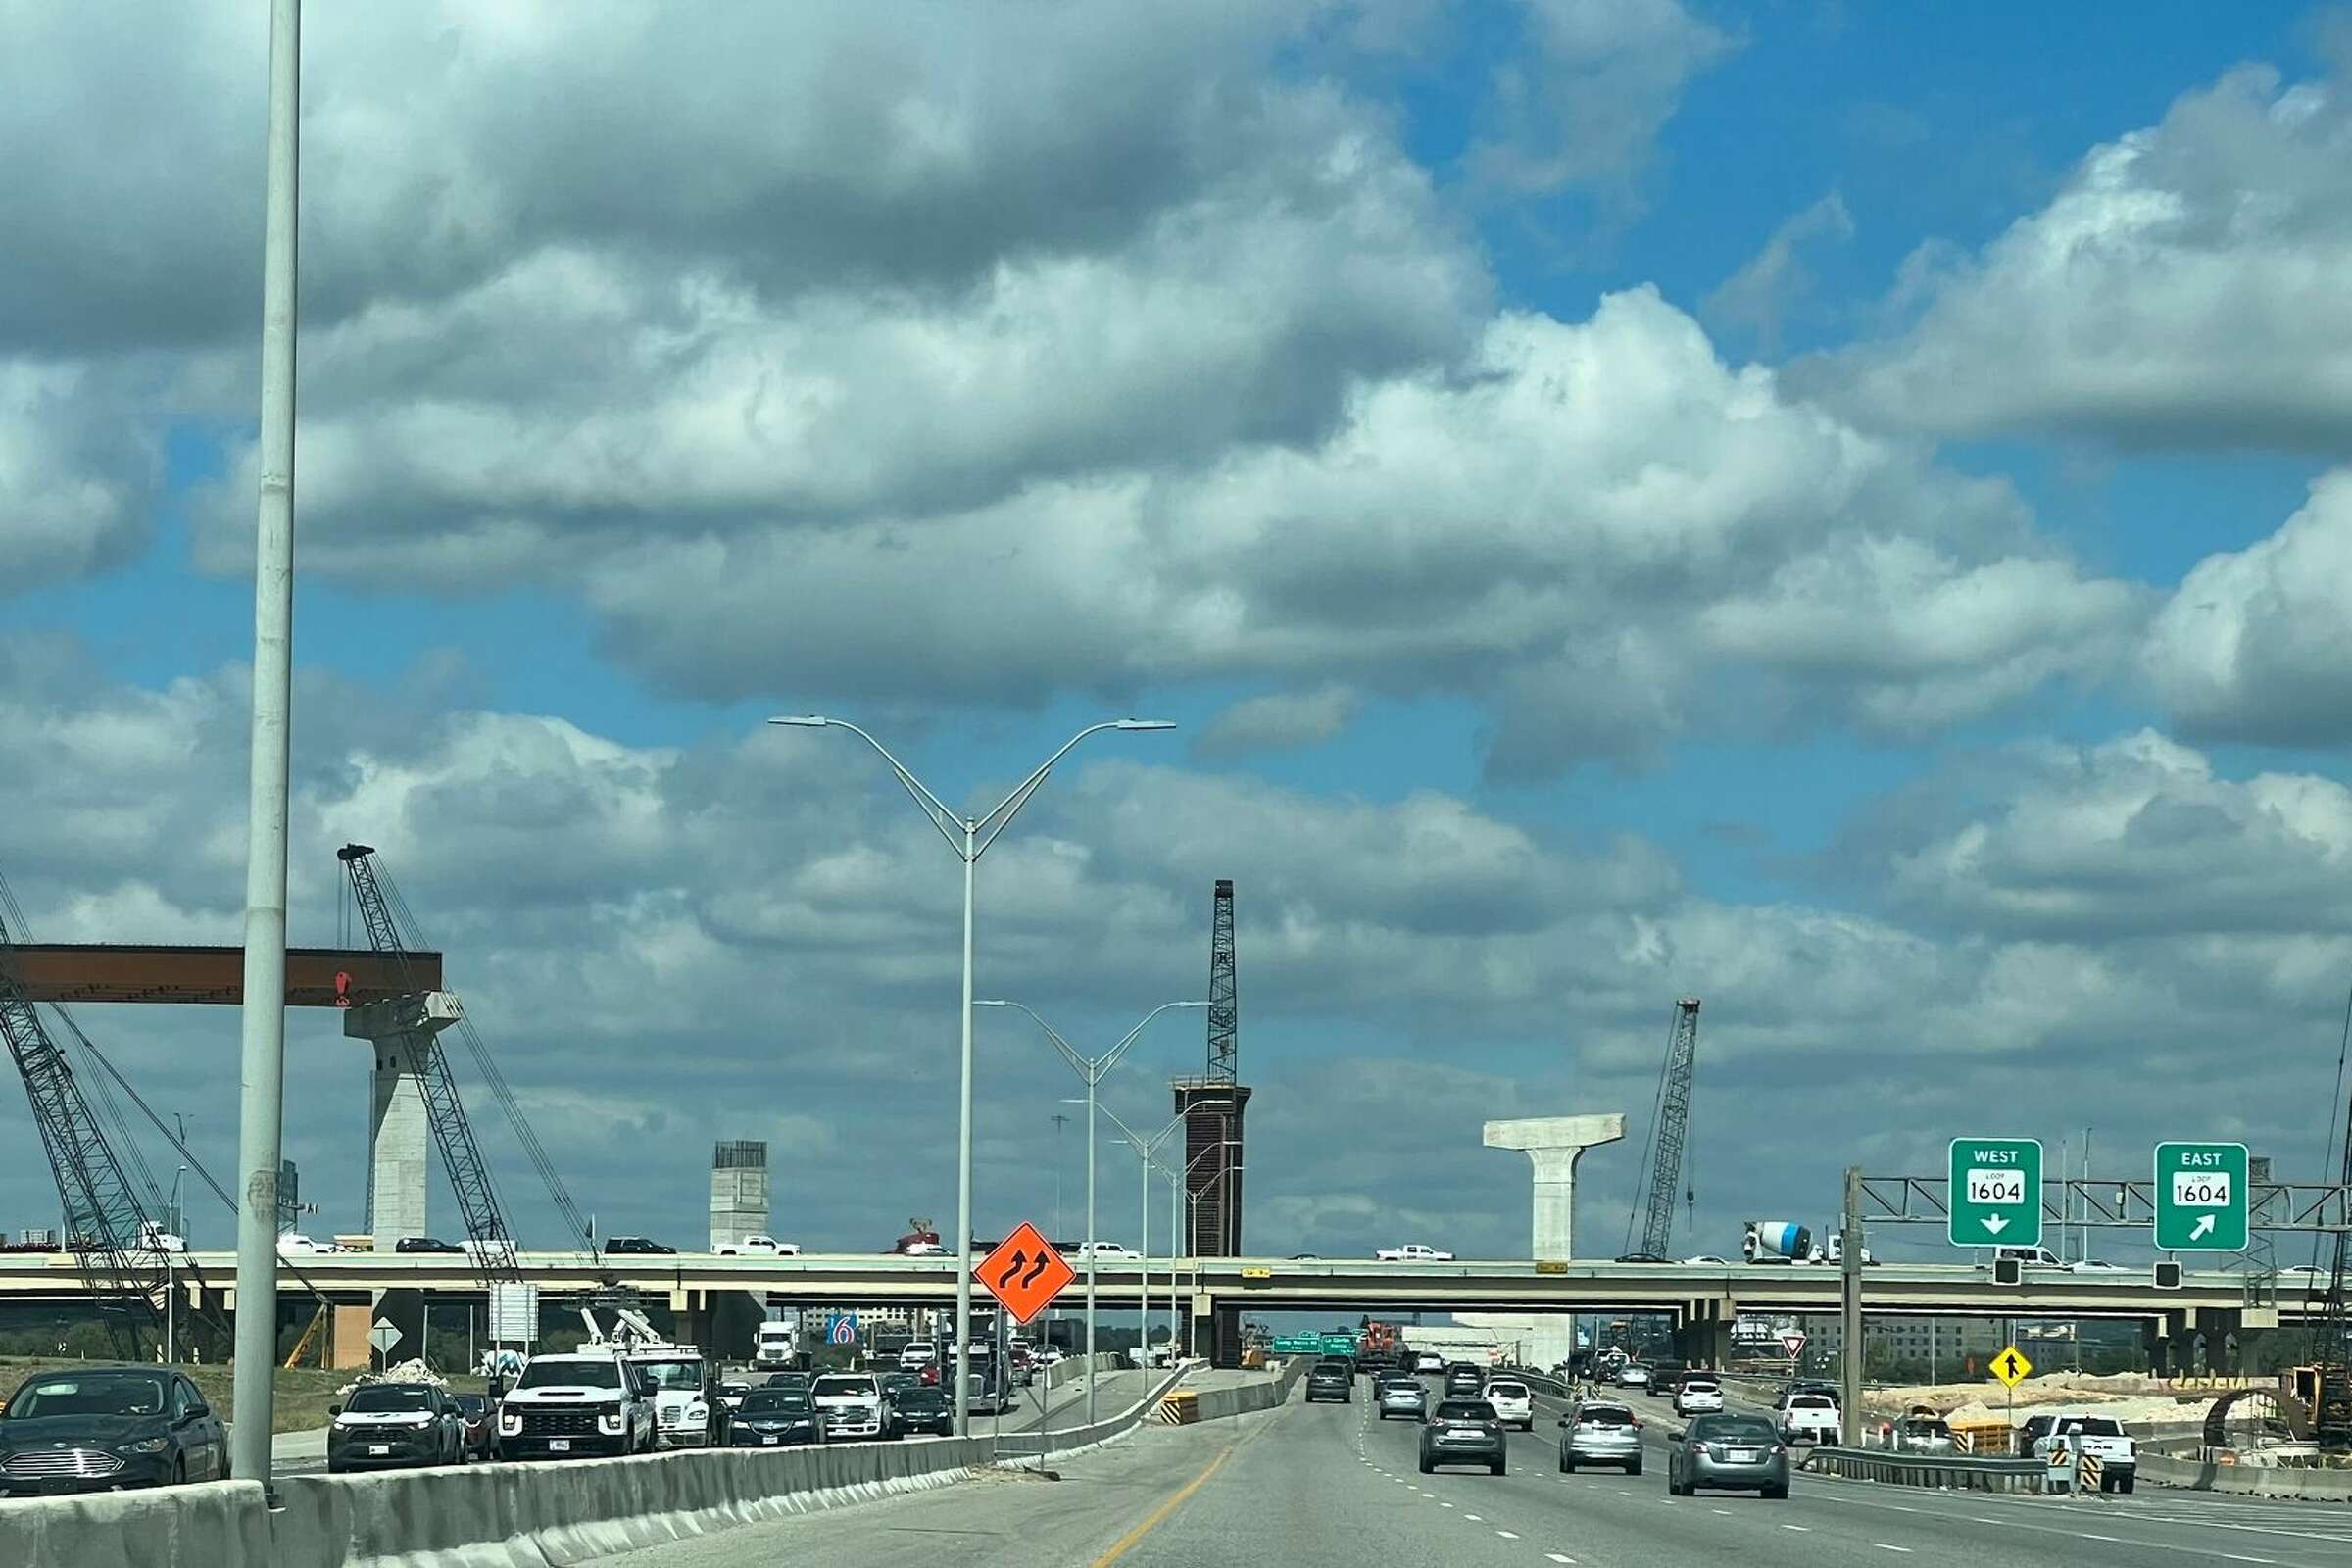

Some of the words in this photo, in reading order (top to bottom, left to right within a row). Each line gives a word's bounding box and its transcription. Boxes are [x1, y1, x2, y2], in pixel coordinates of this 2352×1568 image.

[1973, 1150, 2019, 1163] WEST
[2181, 1152, 2223, 1166] EAST
[1971, 1181, 2020, 1200] 1604
[2177, 1184, 2227, 1202] 1604
[833, 1316, 855, 1344] 6
